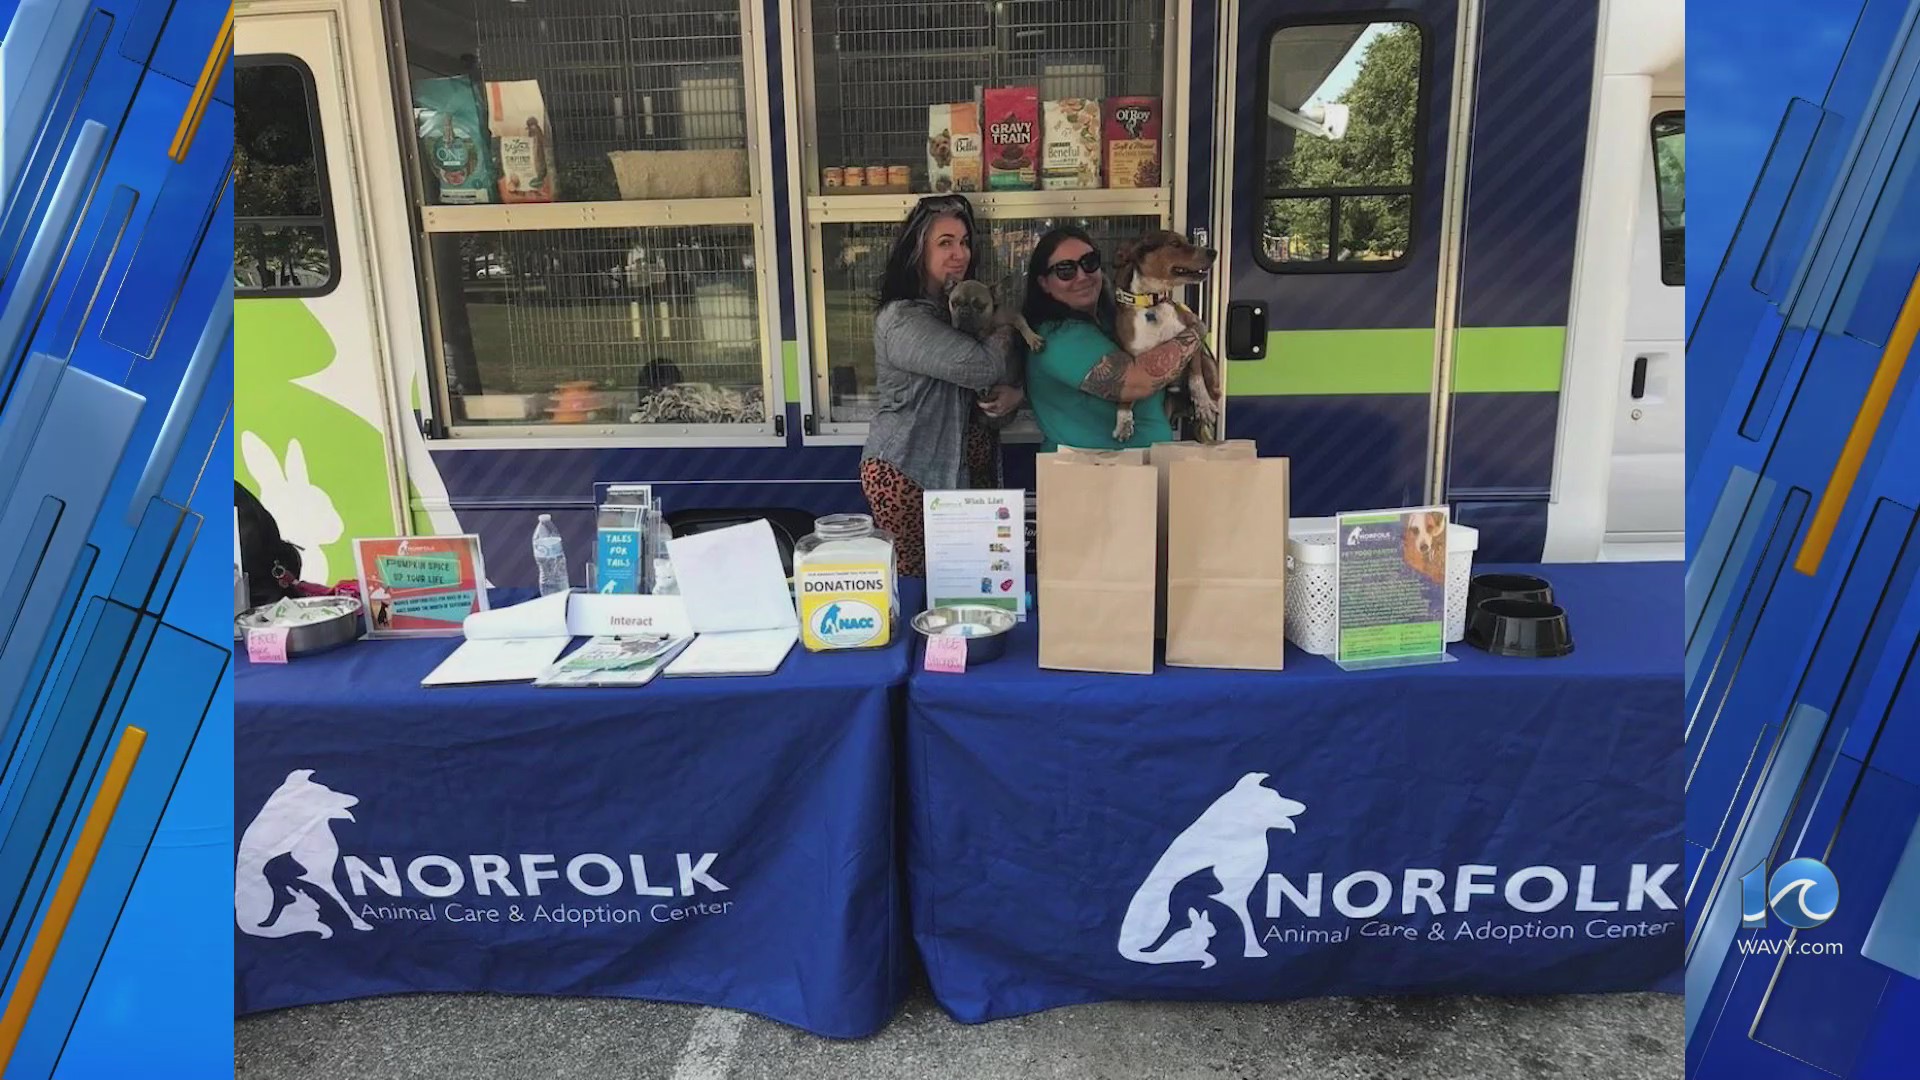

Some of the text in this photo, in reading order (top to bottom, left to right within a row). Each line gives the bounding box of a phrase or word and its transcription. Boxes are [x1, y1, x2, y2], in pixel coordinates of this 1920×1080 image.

[990, 122, 1031, 134] GRAVY
[991, 132, 1031, 145] TRAIN
[1048, 145, 1080, 159] Beneful
[964, 497, 985, 505] Wish
[988, 497, 1004, 505] List
[606, 534, 632, 543] TALES
[609, 546, 628, 555] FOR
[429, 561, 450, 571] SPICE
[606, 559, 630, 567] TAILS
[407, 575, 425, 583] YOUR
[428, 575, 444, 584] LIFE
[804, 579, 884, 592] DONATIONS
[610, 615, 653, 627] Interact
[839, 617, 874, 630] NACC
[343, 852, 730, 898] NORFOLK
[1265, 863, 1680, 919] NORFOLK
[361, 900, 734, 928] Animal Care & Adoption Center
[1263, 918, 1675, 945] Animal Care & Adoption Center
